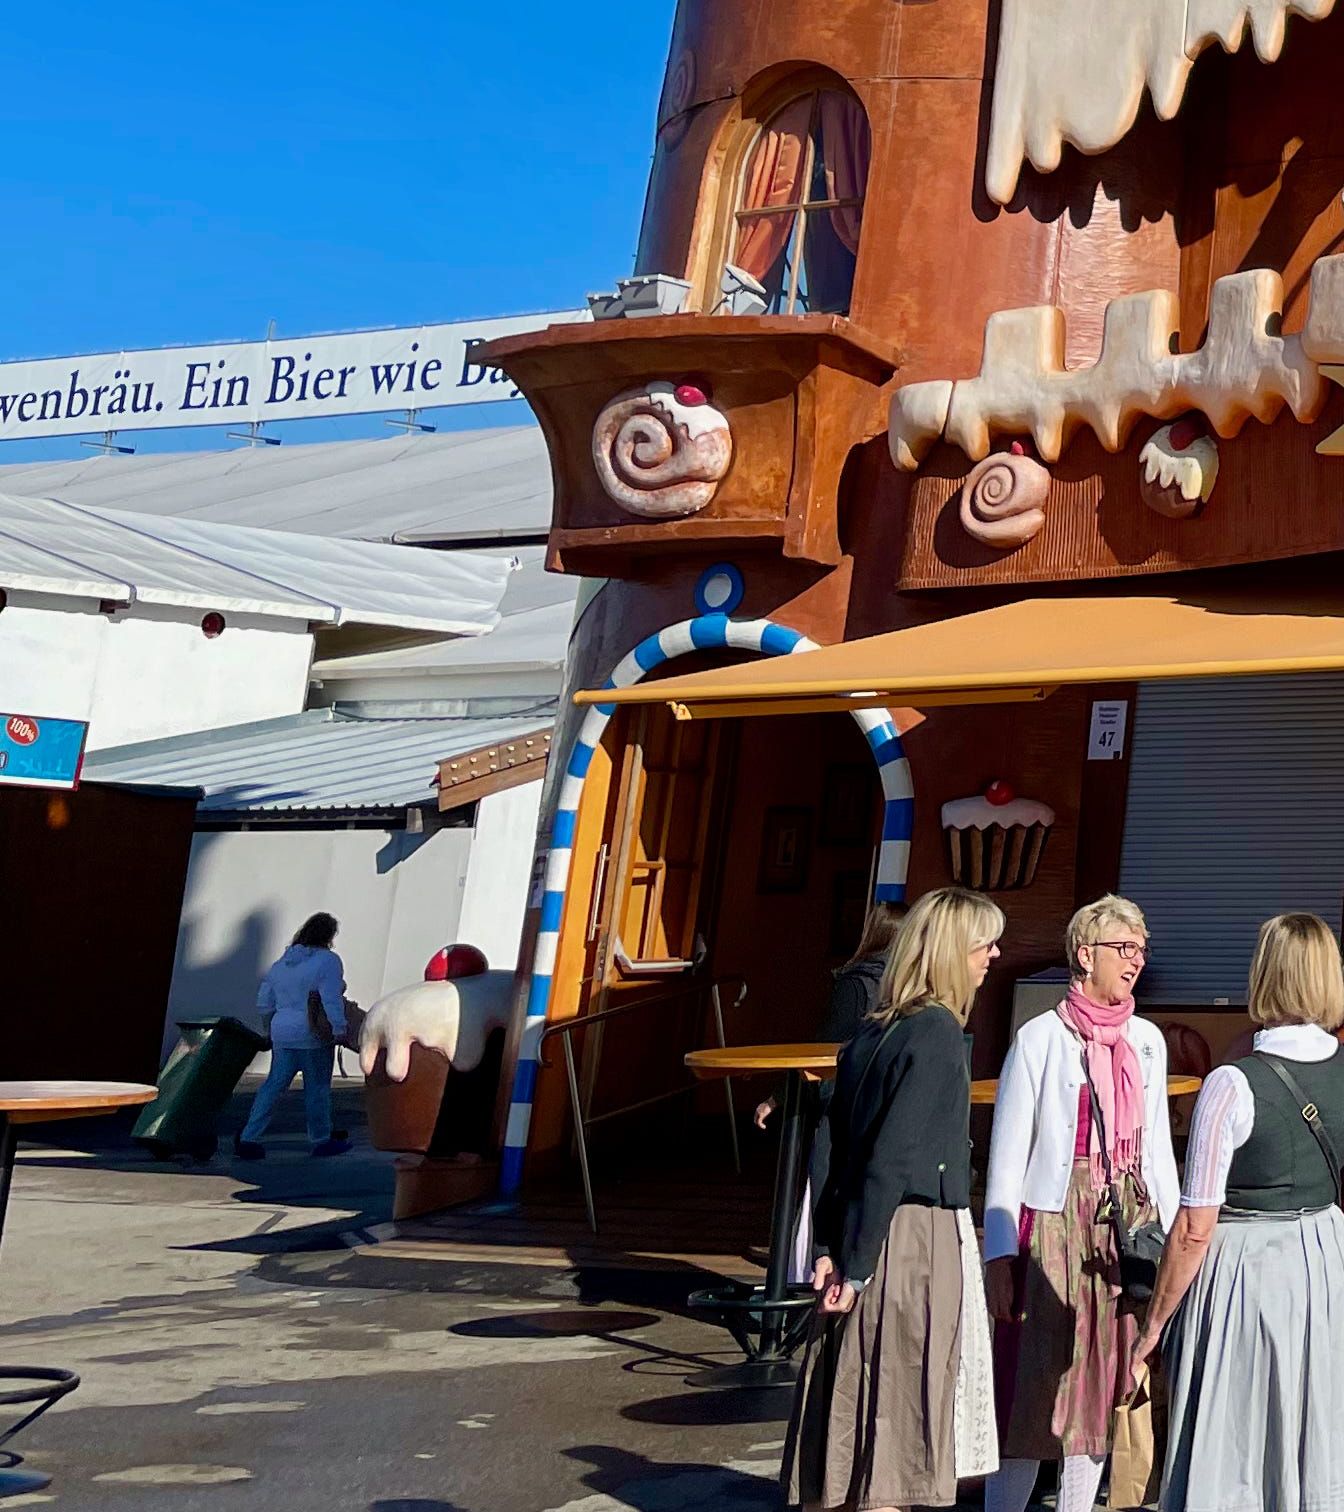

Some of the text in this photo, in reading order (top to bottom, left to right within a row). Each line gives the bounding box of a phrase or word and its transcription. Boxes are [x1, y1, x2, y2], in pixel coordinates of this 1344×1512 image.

[179, 359, 249, 410] Ein
[264, 352, 356, 404] Bier
[370, 342, 442, 395] wie
[10, 717, 35, 742] 100%
[1098, 731, 1116, 747] 47
